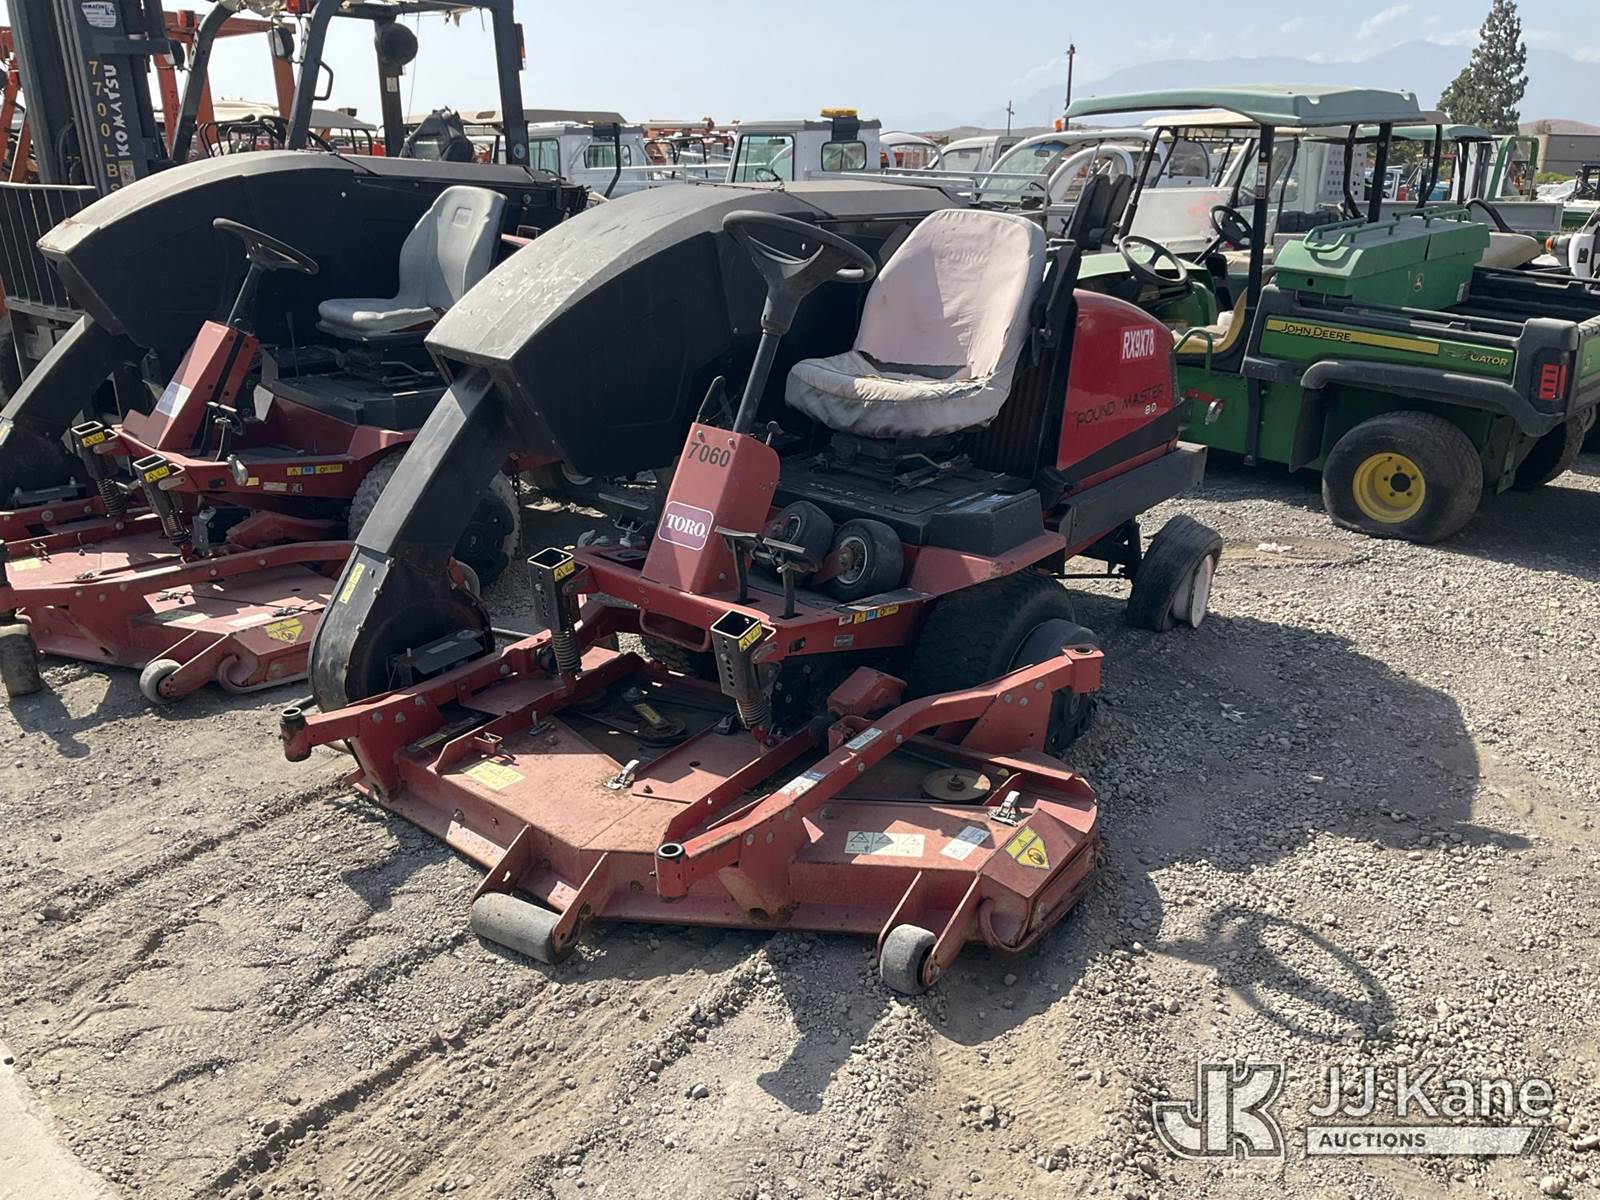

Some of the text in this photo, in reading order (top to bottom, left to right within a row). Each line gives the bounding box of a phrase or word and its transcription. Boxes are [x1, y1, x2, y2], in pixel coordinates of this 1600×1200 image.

[103, 64, 131, 157] KOMATSU
[1121, 328, 1156, 360] RX9X78
[1281, 322, 1352, 341] JOHN DEERE
[687, 441, 732, 469] 7060
